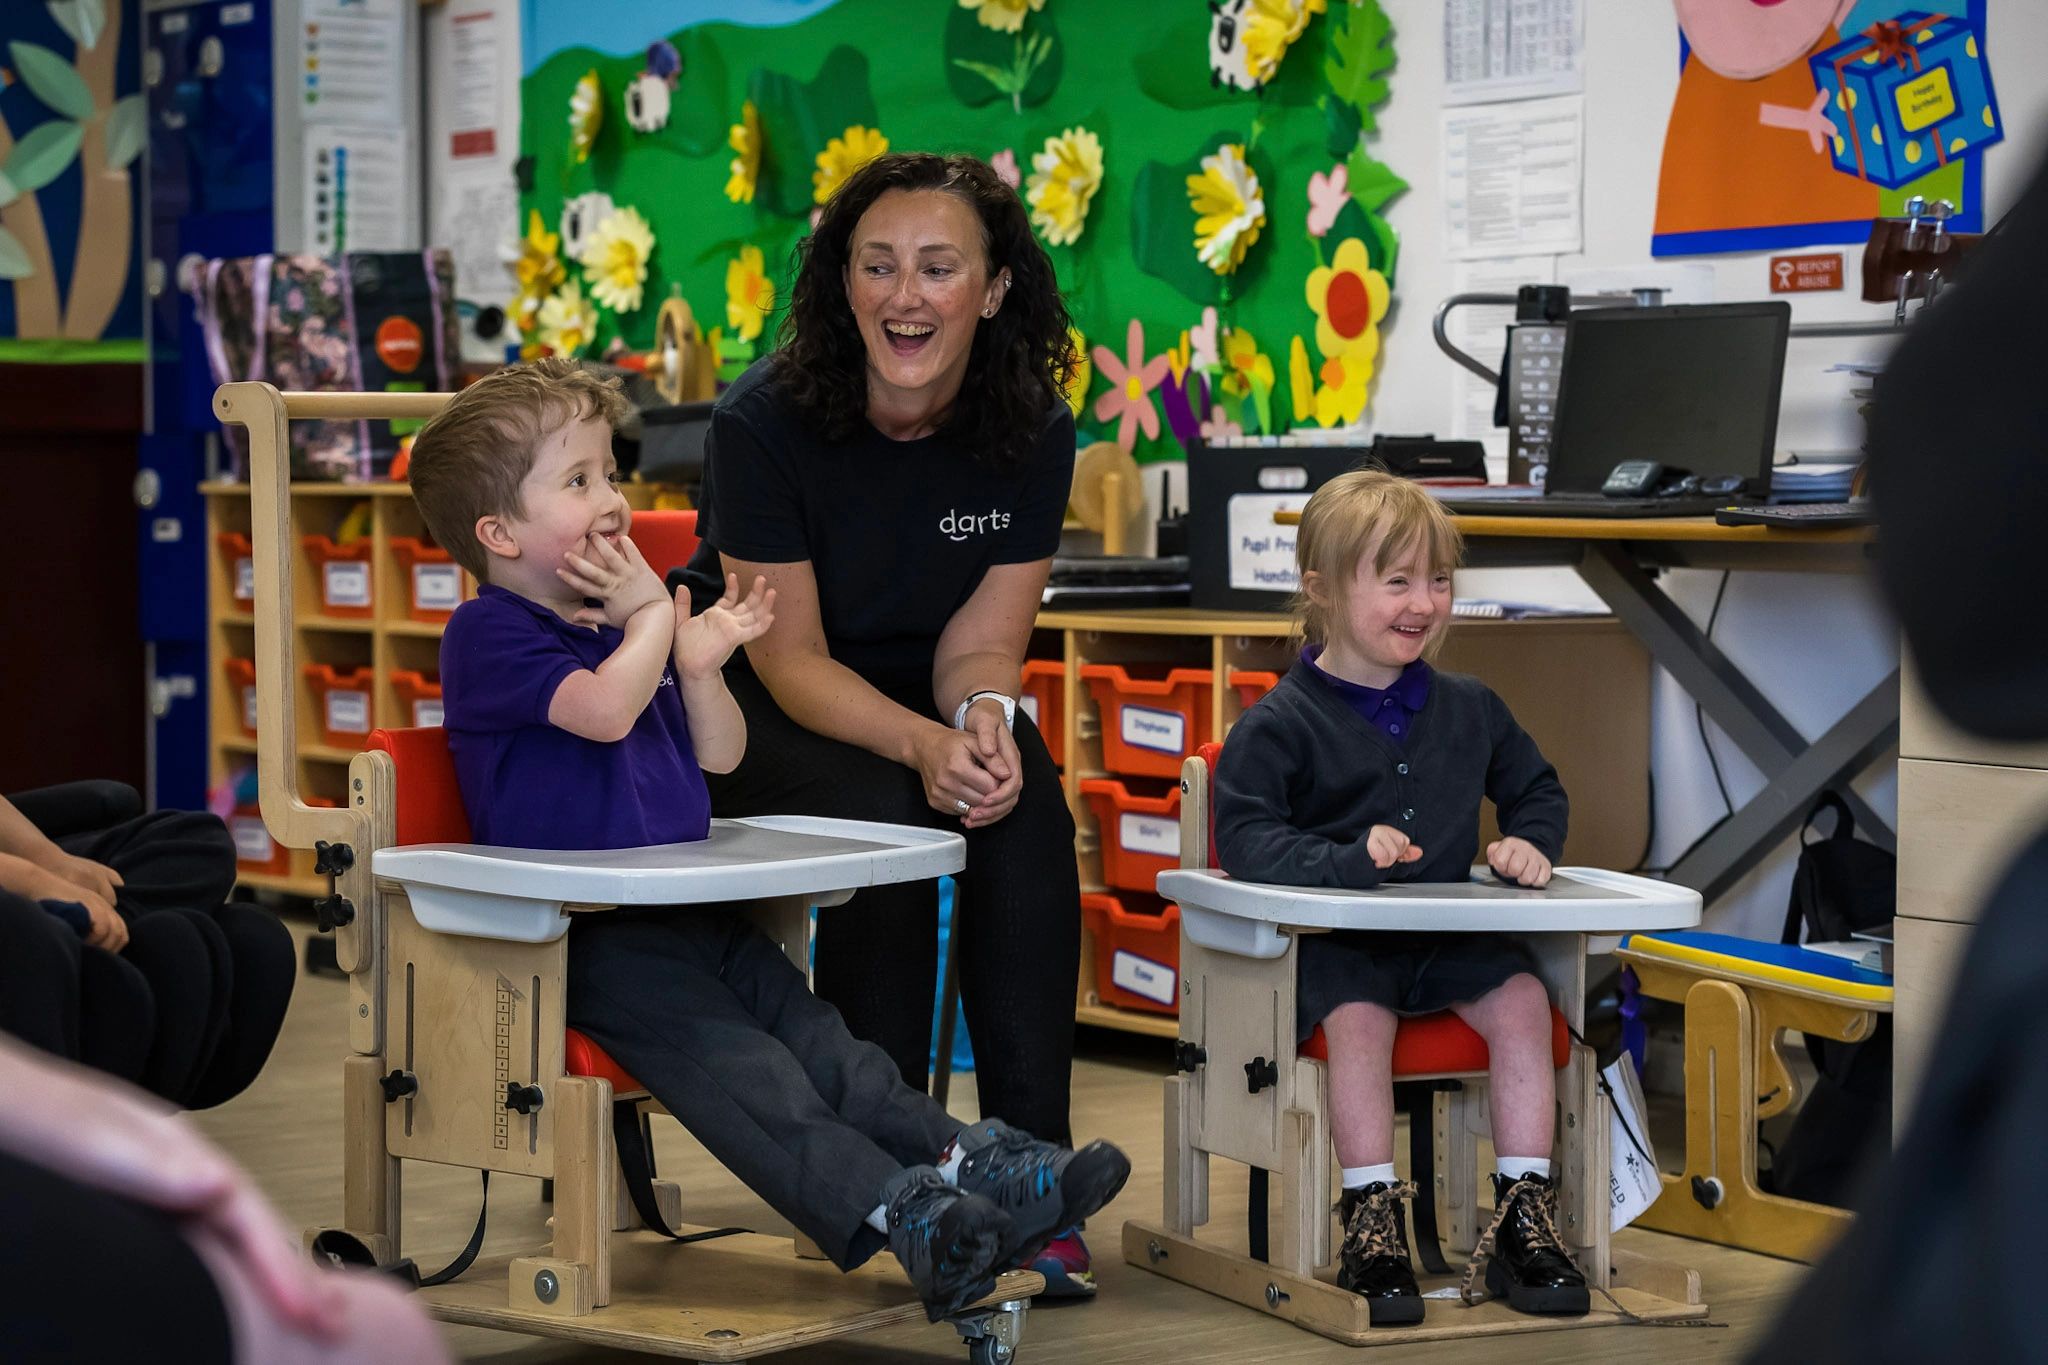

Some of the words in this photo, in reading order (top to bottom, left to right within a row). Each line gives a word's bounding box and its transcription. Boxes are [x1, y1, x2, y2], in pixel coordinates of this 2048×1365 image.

[1796, 259, 1837, 273] REPORT
[1797, 274, 1832, 288] ABUSE
[939, 508, 1011, 536] darts
[1242, 536, 1271, 555] Pupil
